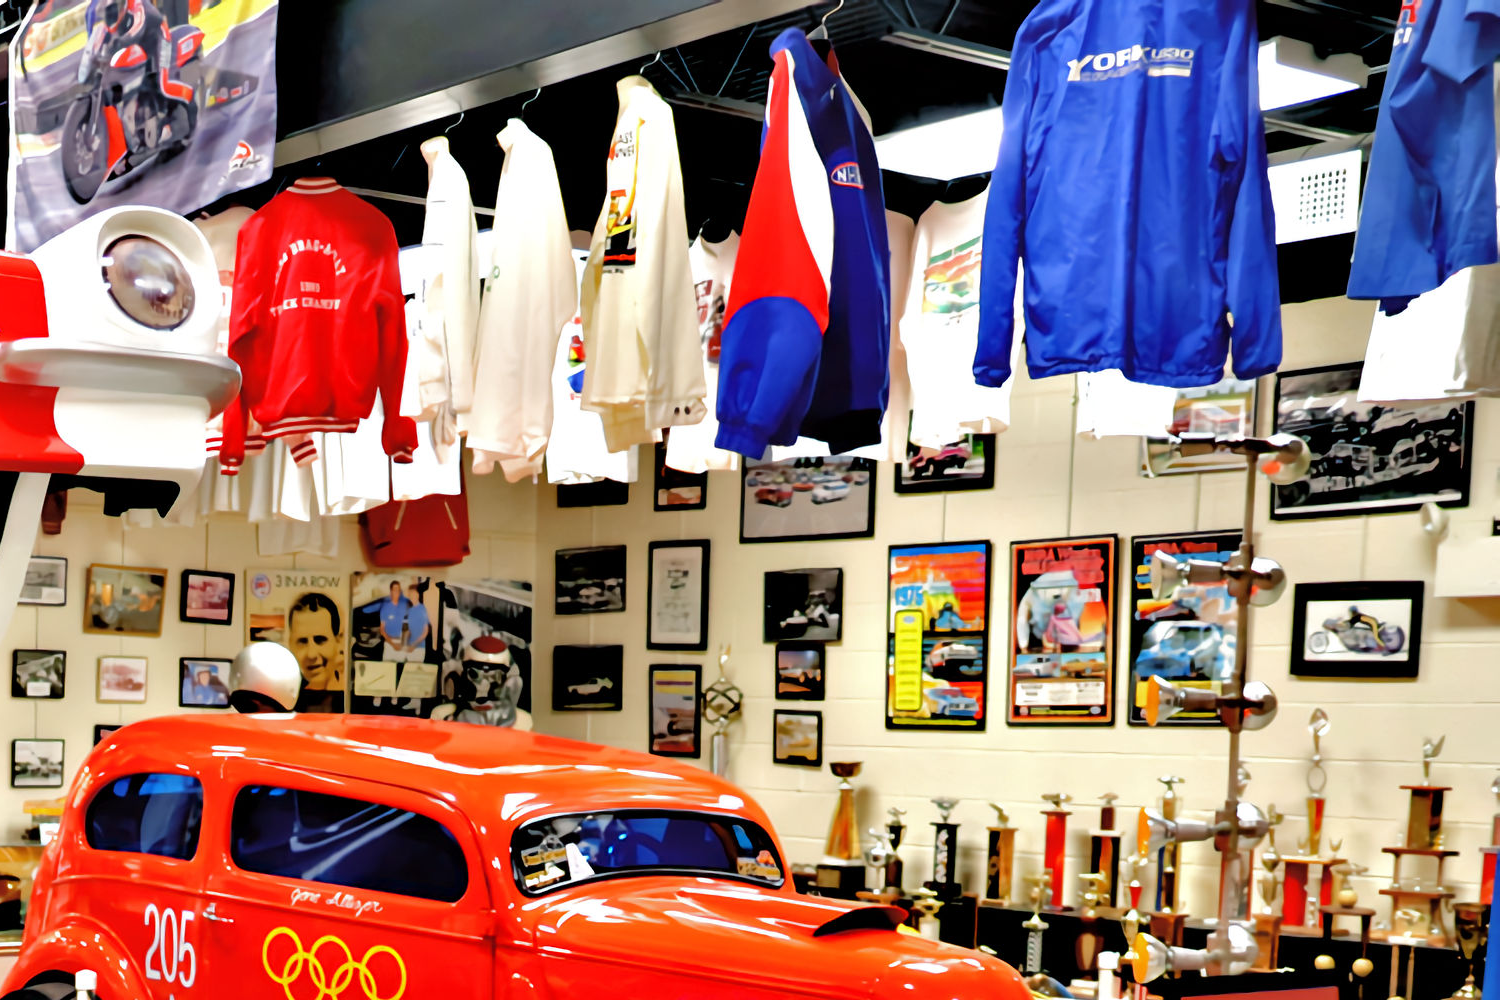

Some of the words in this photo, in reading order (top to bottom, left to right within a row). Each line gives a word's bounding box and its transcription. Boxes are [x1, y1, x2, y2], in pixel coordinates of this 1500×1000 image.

[1067, 44, 1150, 81] YORK
[310, 576, 340, 588] ROW
[144, 903, 197, 988] 205
